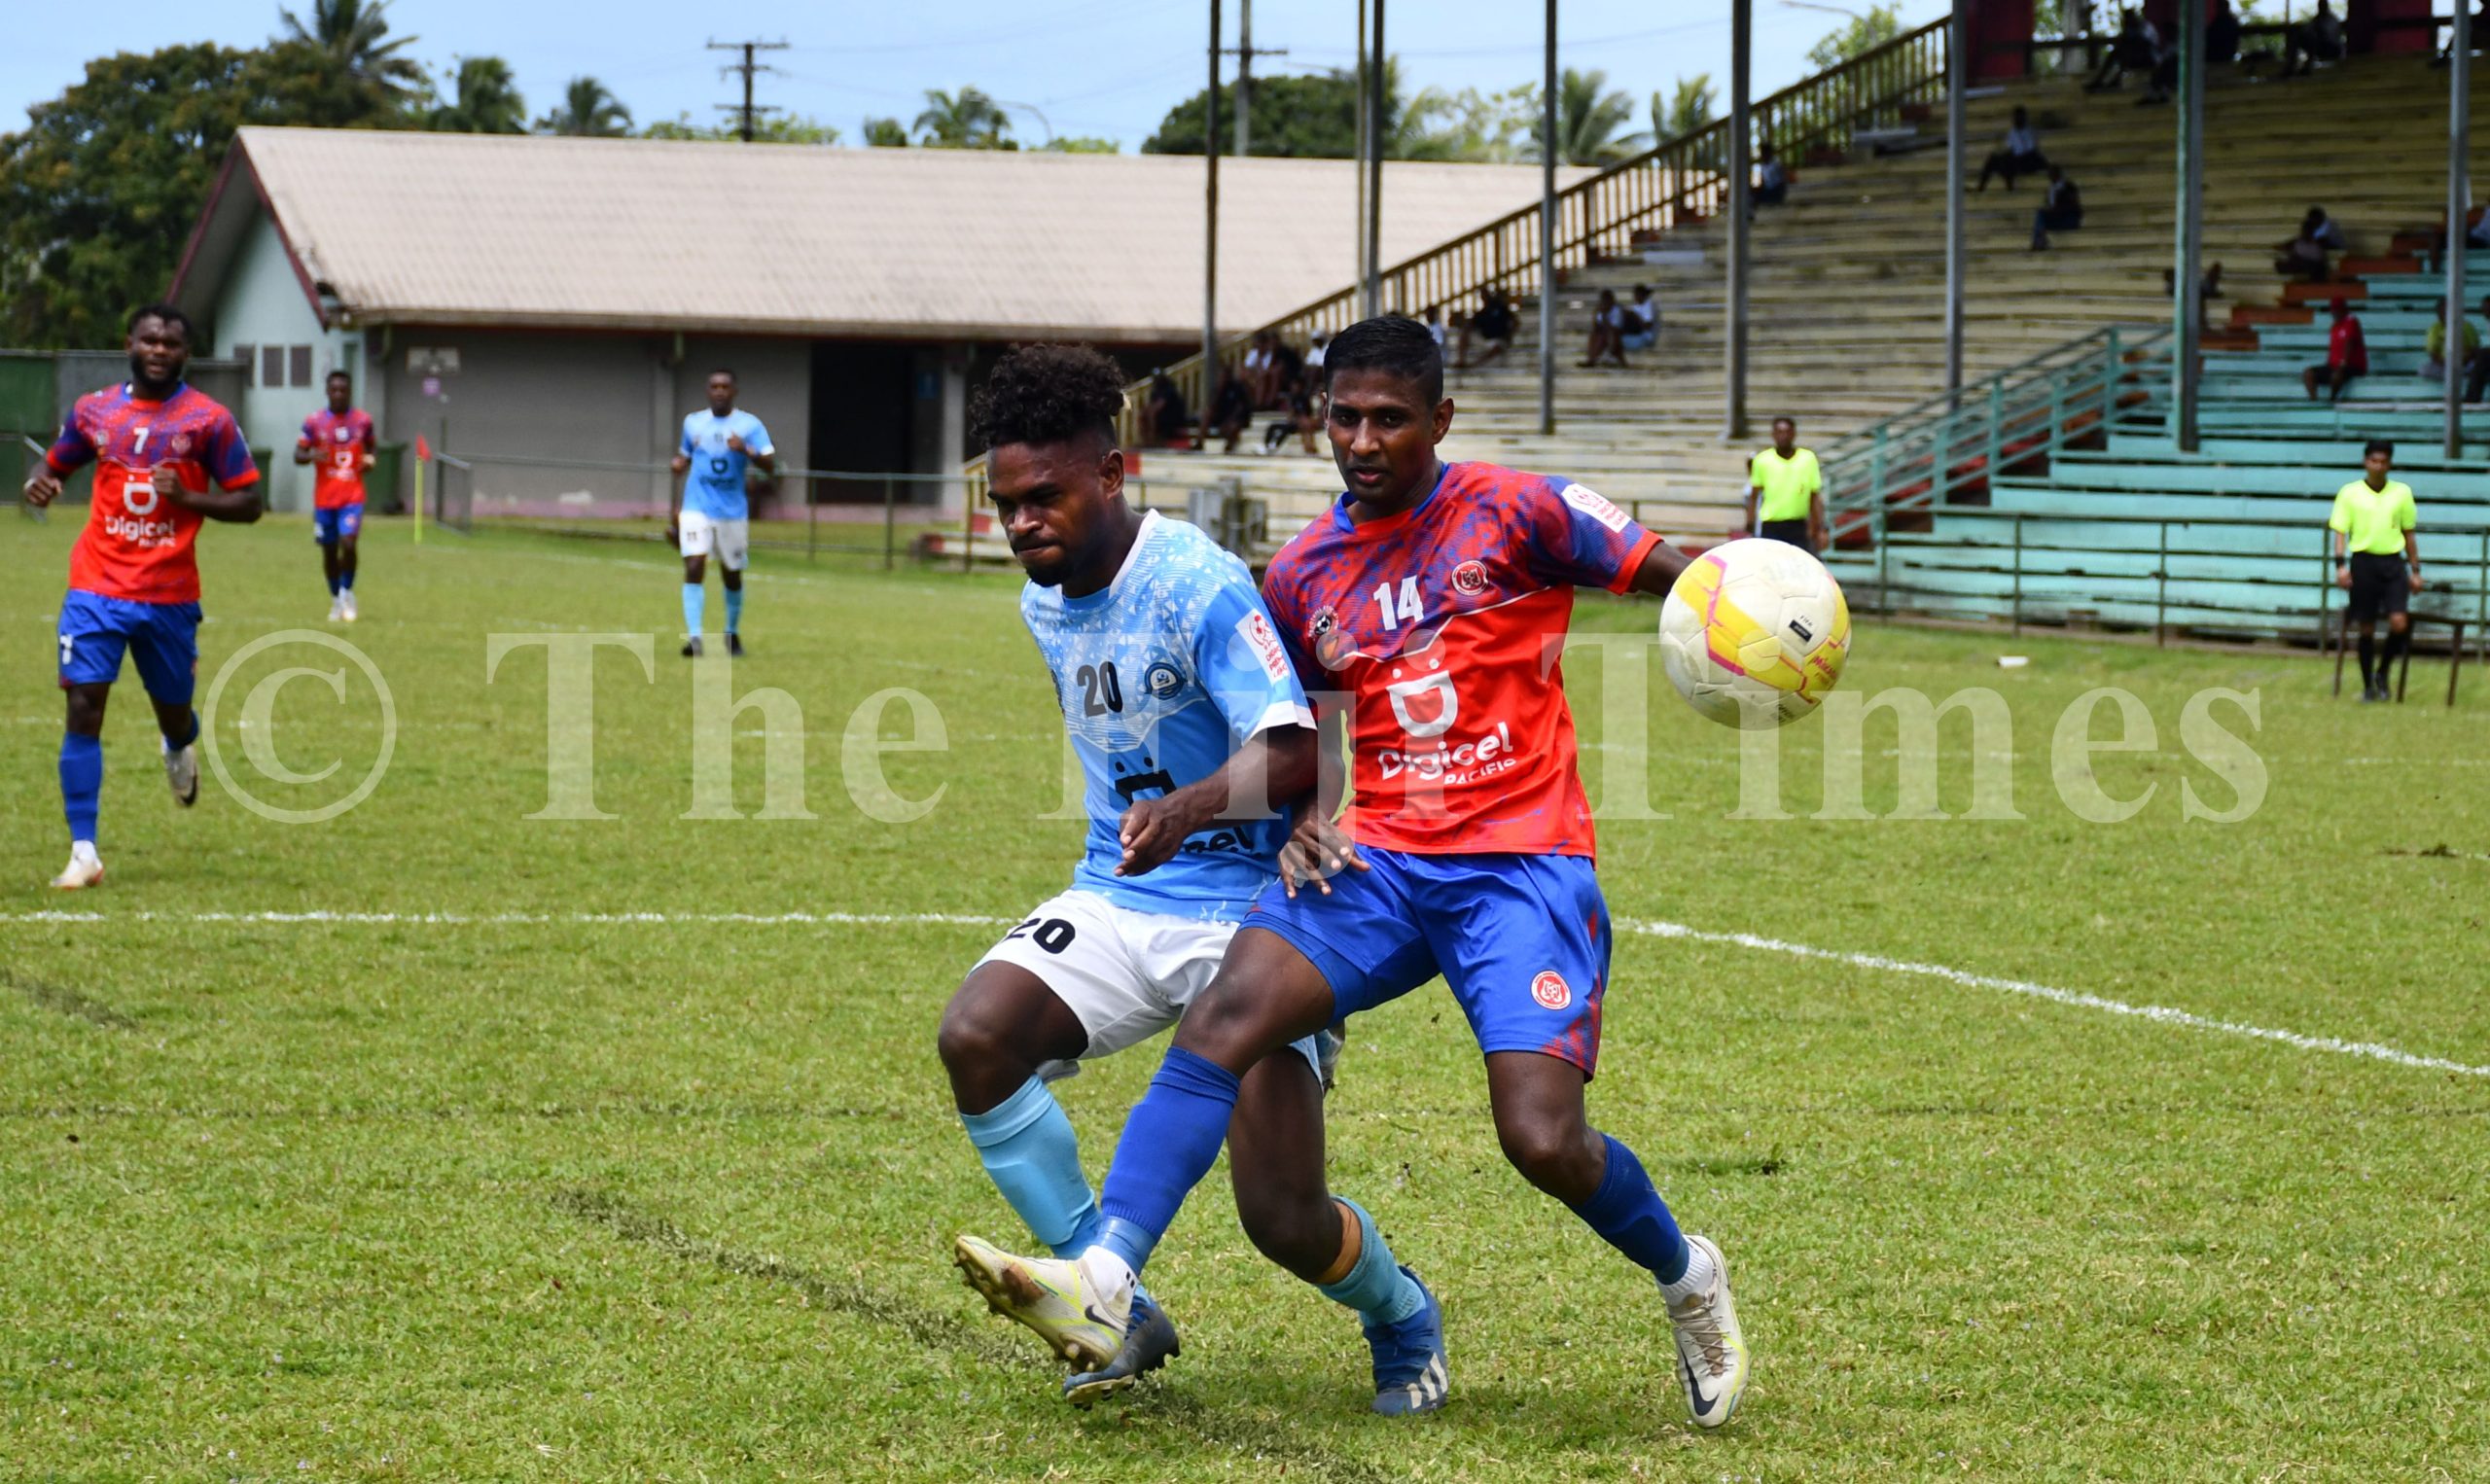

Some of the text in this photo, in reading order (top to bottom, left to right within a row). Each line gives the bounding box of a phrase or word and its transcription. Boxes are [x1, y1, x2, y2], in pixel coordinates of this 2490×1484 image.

[133, 427, 150, 454] 7
[104, 515, 175, 542] Digicel
[1372, 575, 1425, 631] 14
[1077, 661, 1123, 719] 20
[1378, 722, 1513, 780] Digicel
